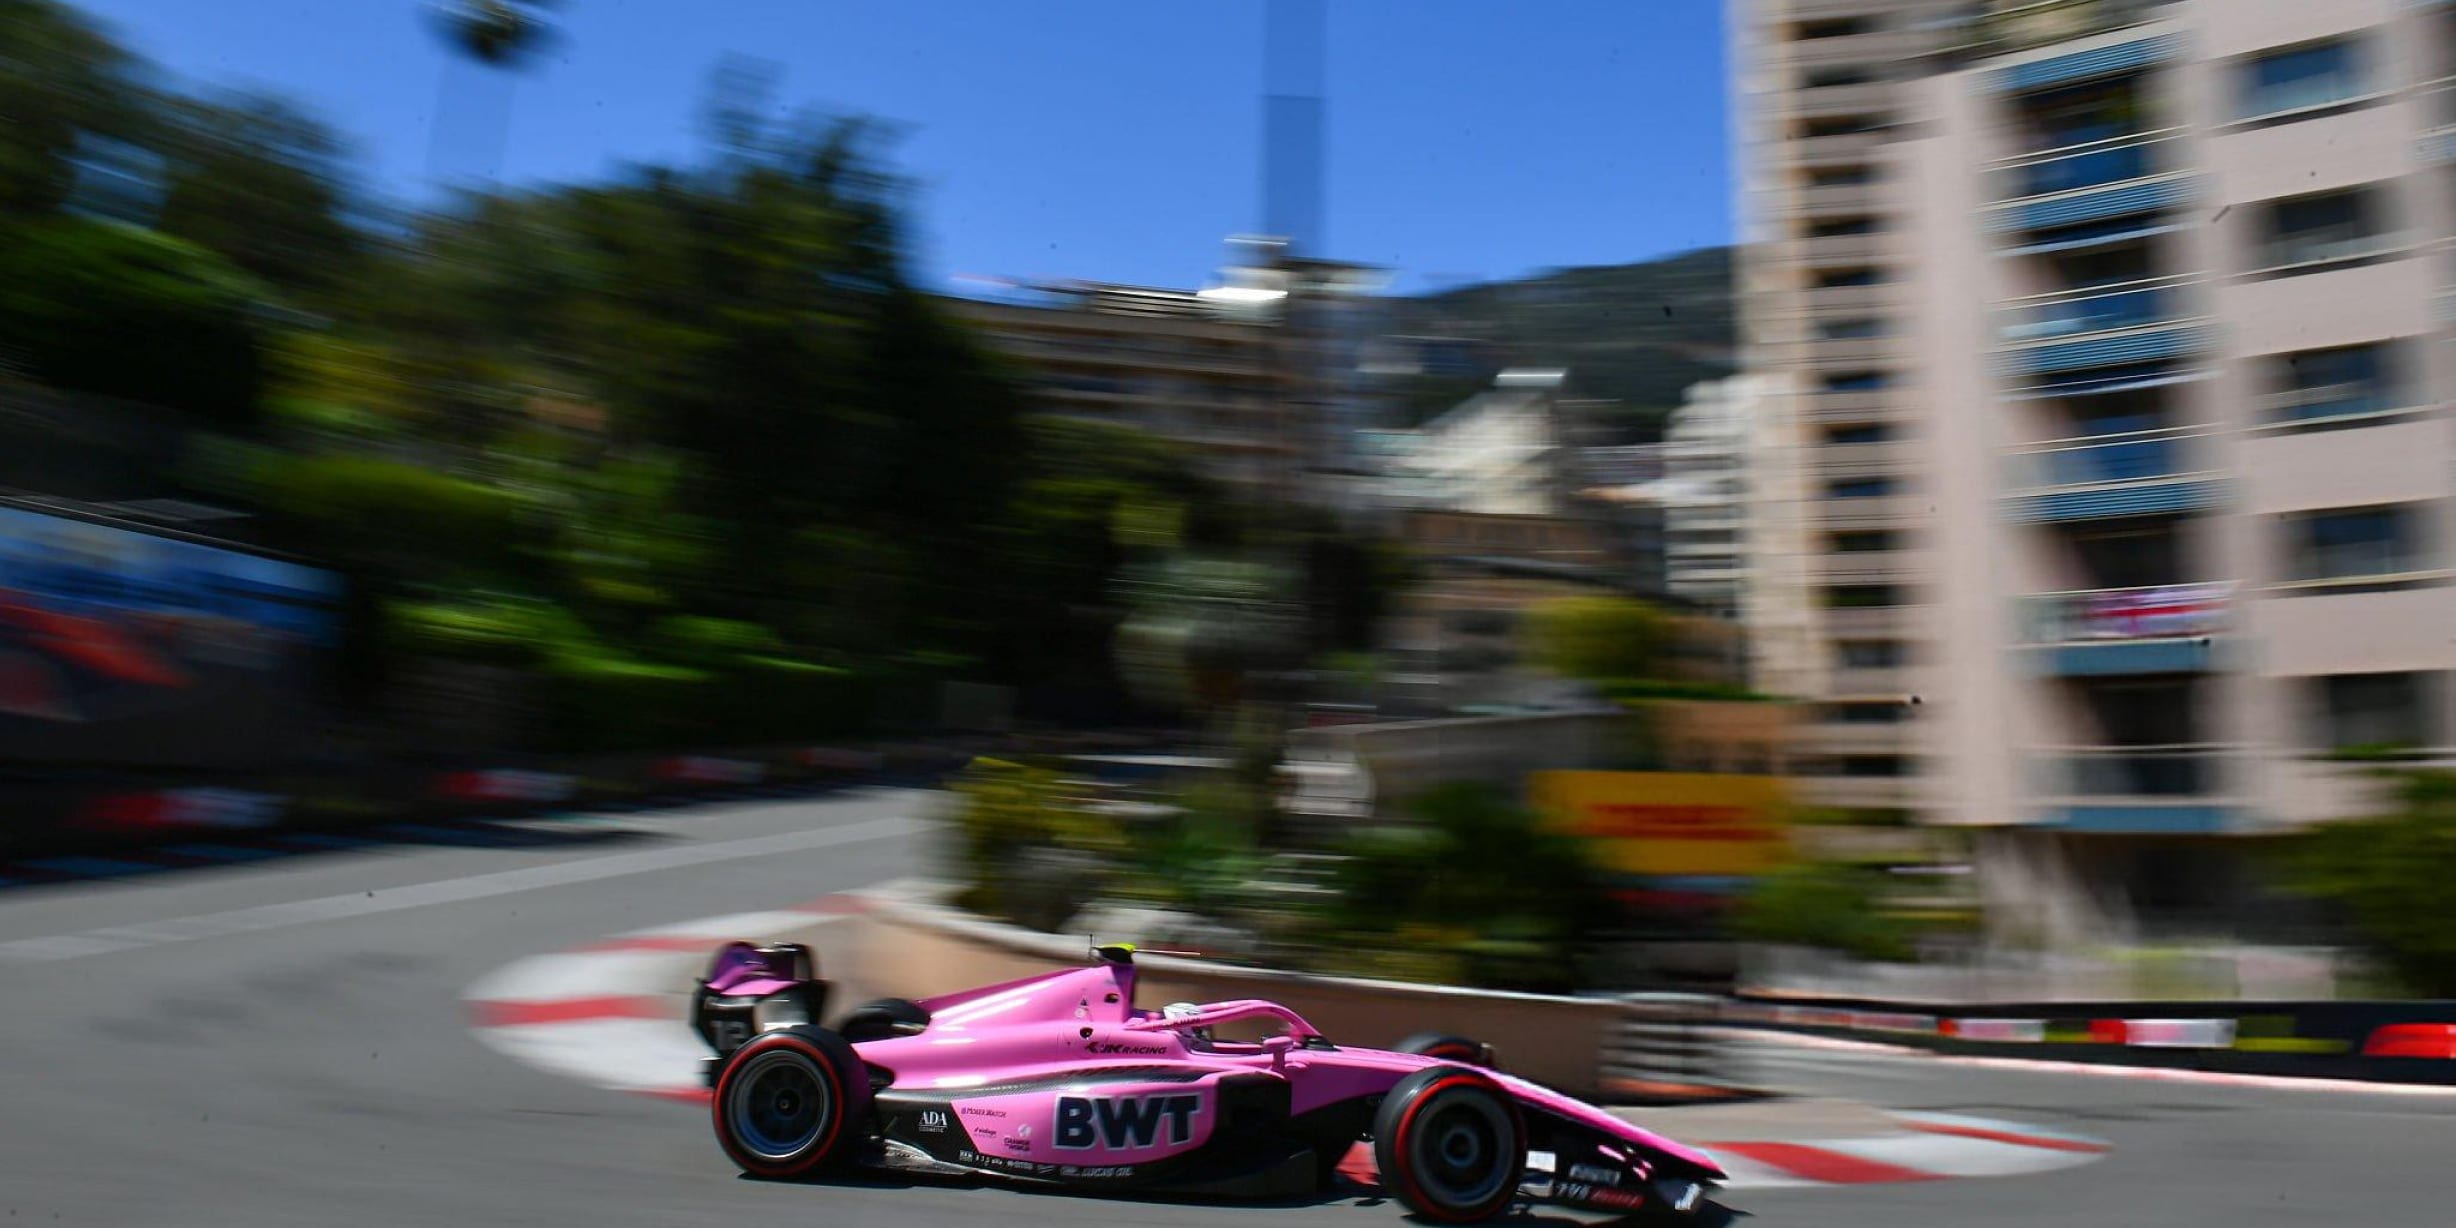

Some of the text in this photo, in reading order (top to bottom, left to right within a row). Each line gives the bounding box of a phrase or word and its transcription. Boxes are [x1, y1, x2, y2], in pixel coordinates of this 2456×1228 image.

[1122, 1046, 1168, 1054] RACING
[919, 1110, 948, 1126] ADA
[1054, 1095, 1202, 1149] BWT
